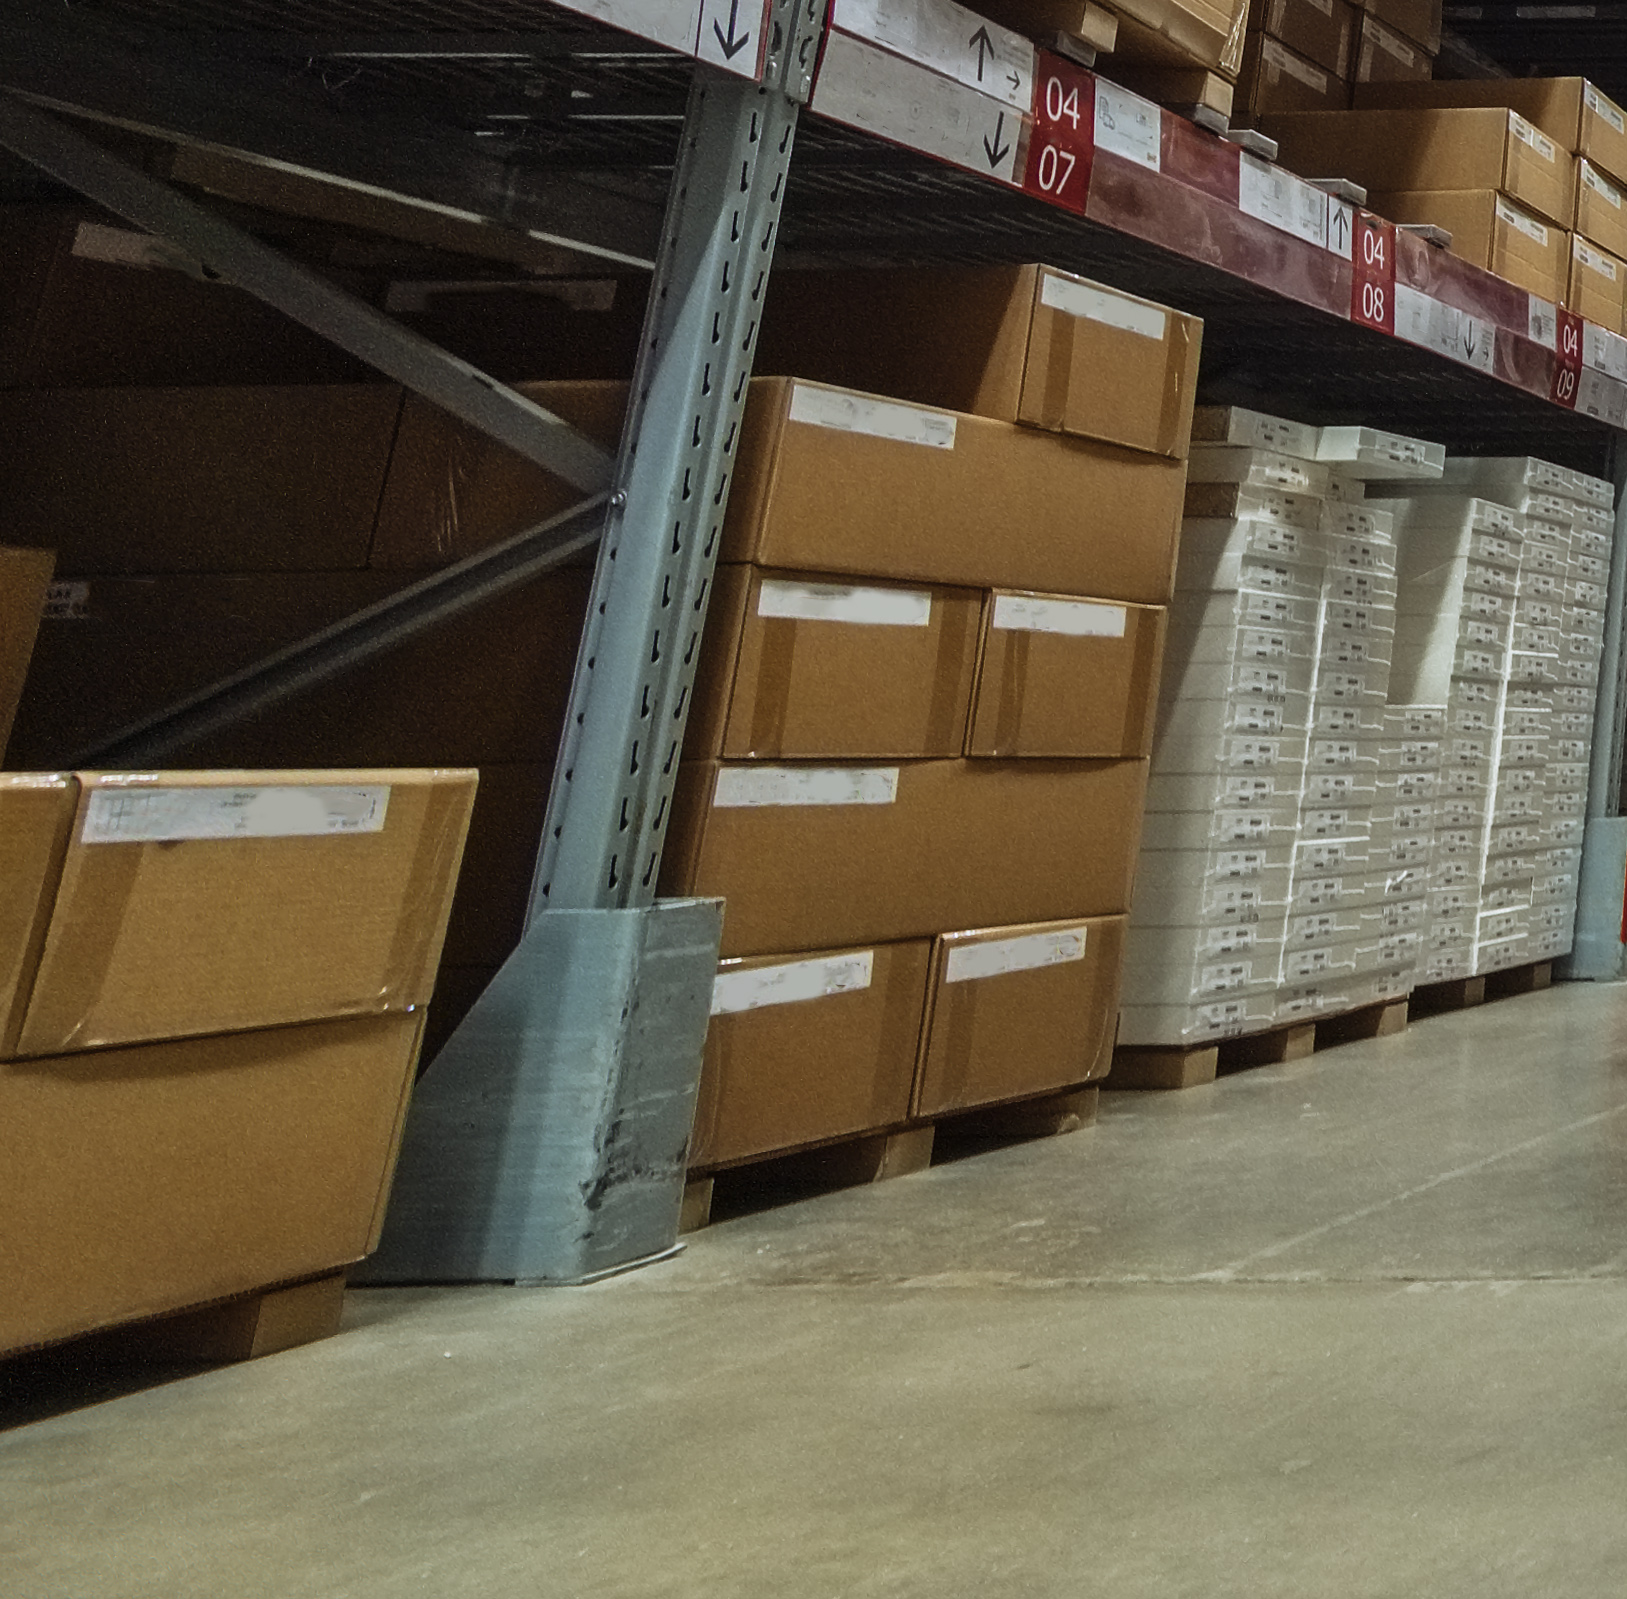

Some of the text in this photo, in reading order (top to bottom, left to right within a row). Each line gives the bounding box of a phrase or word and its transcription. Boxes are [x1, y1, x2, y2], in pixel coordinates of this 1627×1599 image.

[1046, 76, 1081, 130] 04
[1038, 144, 1076, 195] 07
[1363, 229, 1385, 271] 04
[1362, 281, 1384, 323] 08
[1563, 325, 1579, 358] 04
[1557, 370, 1575, 401] 09
